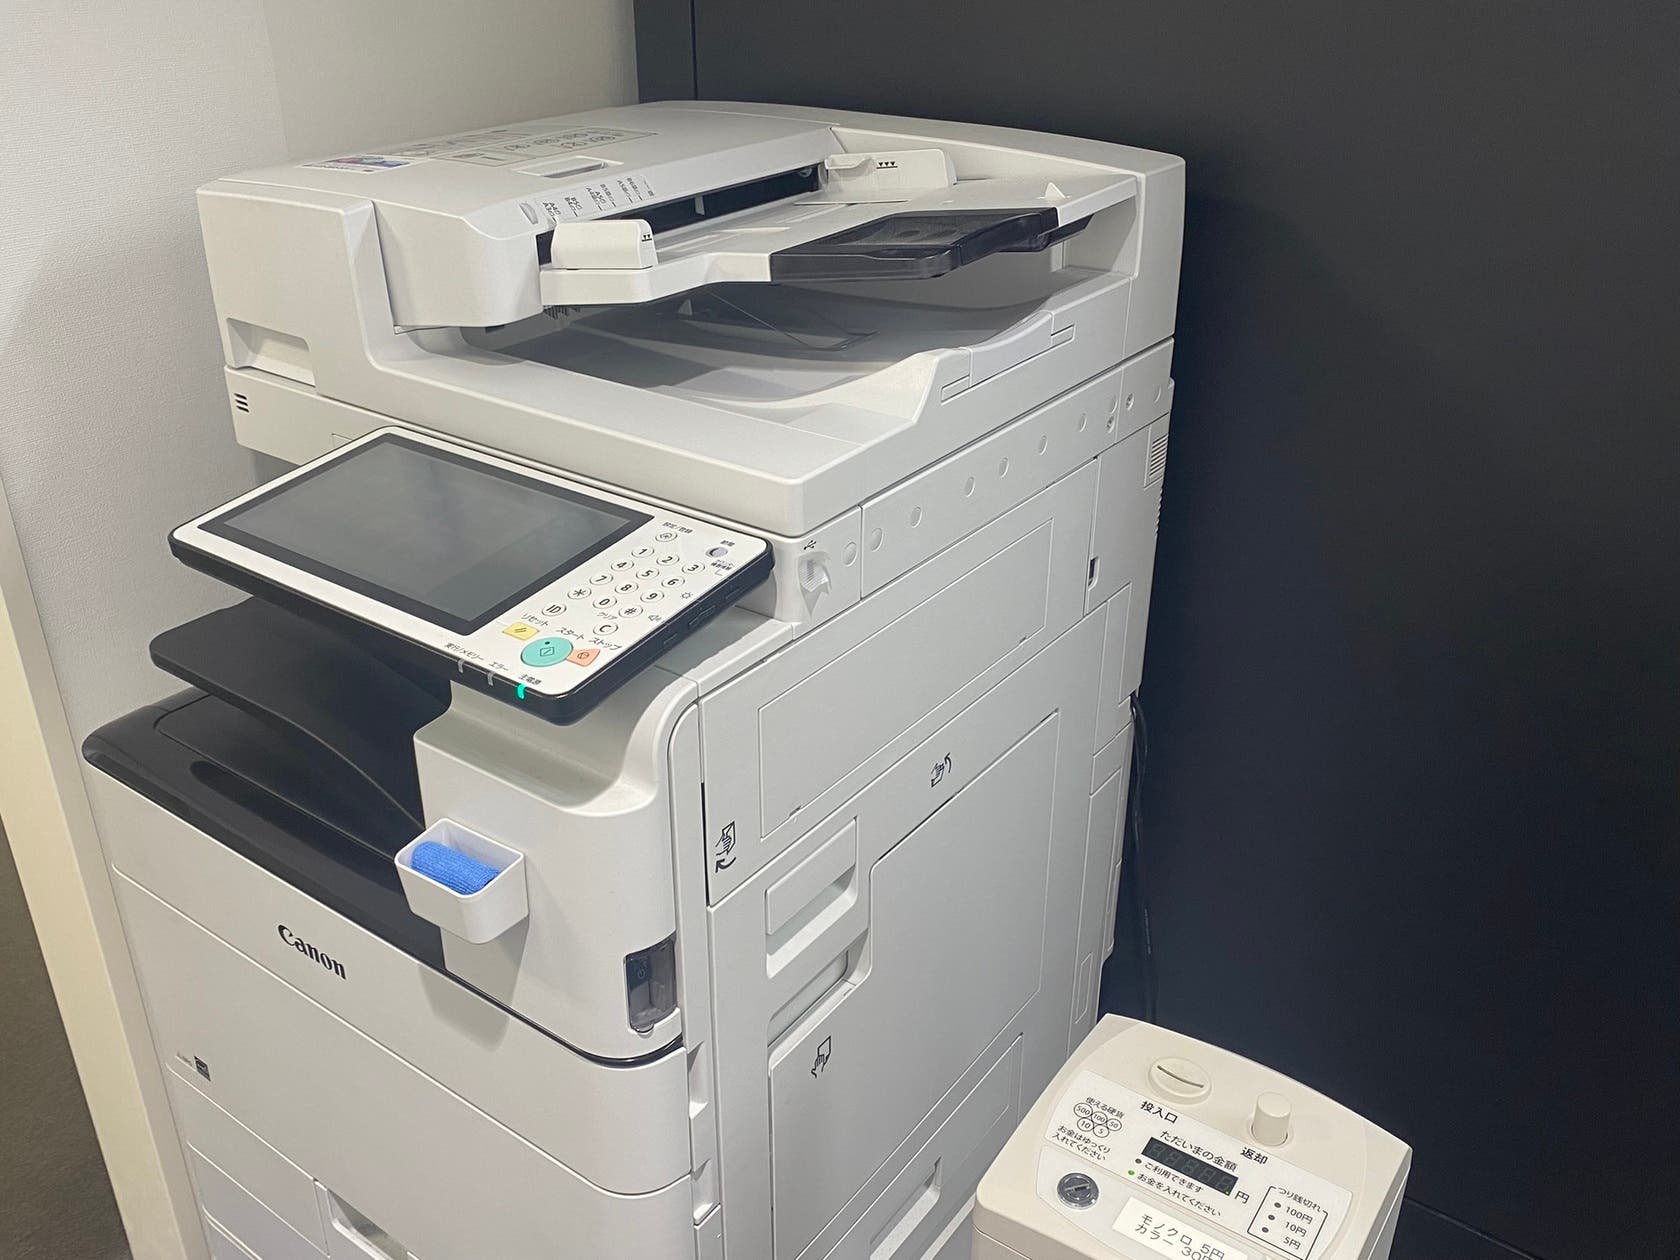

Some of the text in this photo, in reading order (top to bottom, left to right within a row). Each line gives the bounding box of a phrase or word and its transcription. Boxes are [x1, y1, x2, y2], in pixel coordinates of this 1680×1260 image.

[546, 604, 562, 613] ID
[522, 613, 548, 626] リセット
[558, 627, 585, 640] スタート
[588, 637, 622, 650] ストップ
[278, 924, 346, 980] Canon
[1076, 1106, 1090, 1116] 500
[1086, 1096, 1125, 1118] 使える硬貨
[1140, 1100, 1178, 1124] 投入口
[1080, 1120, 1090, 1129] 10
[1093, 1114, 1106, 1123] 100
[1052, 1132, 1106, 1160] 入れてください
[1058, 1125, 1110, 1154] お金はゆっくり
[1160, 1130, 1238, 1172] ただいまの金額
[1240, 1146, 1268, 1166] 返却
[1145, 1162, 1204, 1194] ご利用できます
[1137, 1172, 1221, 1217] お金を入れてください
[1234, 1190, 1250, 1204] 円
[1278, 1188, 1322, 1212] つり銭切れ
[1286, 1206, 1313, 1224] 100円
[1134, 1223, 1174, 1246] カラー
[1142, 1214, 1225, 1260] モノクロ 5円
[1284, 1220, 1307, 1238] 10円
[1283, 1236, 1301, 1250] 5円
